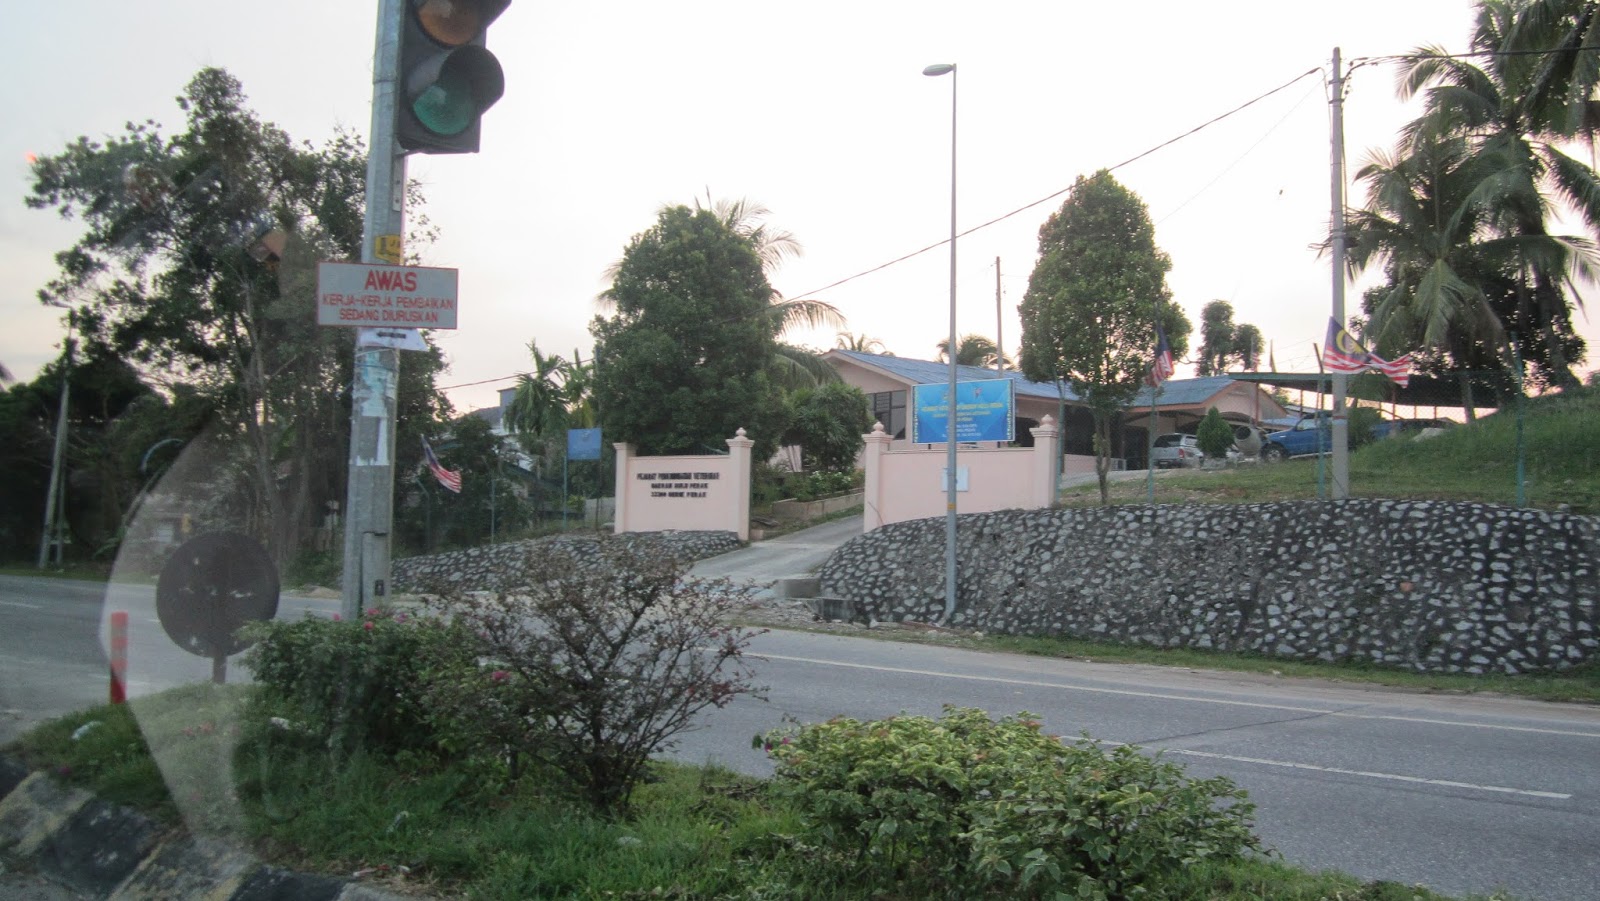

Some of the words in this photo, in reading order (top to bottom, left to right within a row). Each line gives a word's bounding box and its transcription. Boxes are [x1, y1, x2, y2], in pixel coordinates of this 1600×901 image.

[364, 269, 418, 292] AWAS
[322, 293, 392, 307] KERJA-KERJA
[396, 296, 454, 310] PEMBAIKAN
[339, 307, 379, 321] SEDANG
[382, 309, 439, 322] DIURUSKAN
